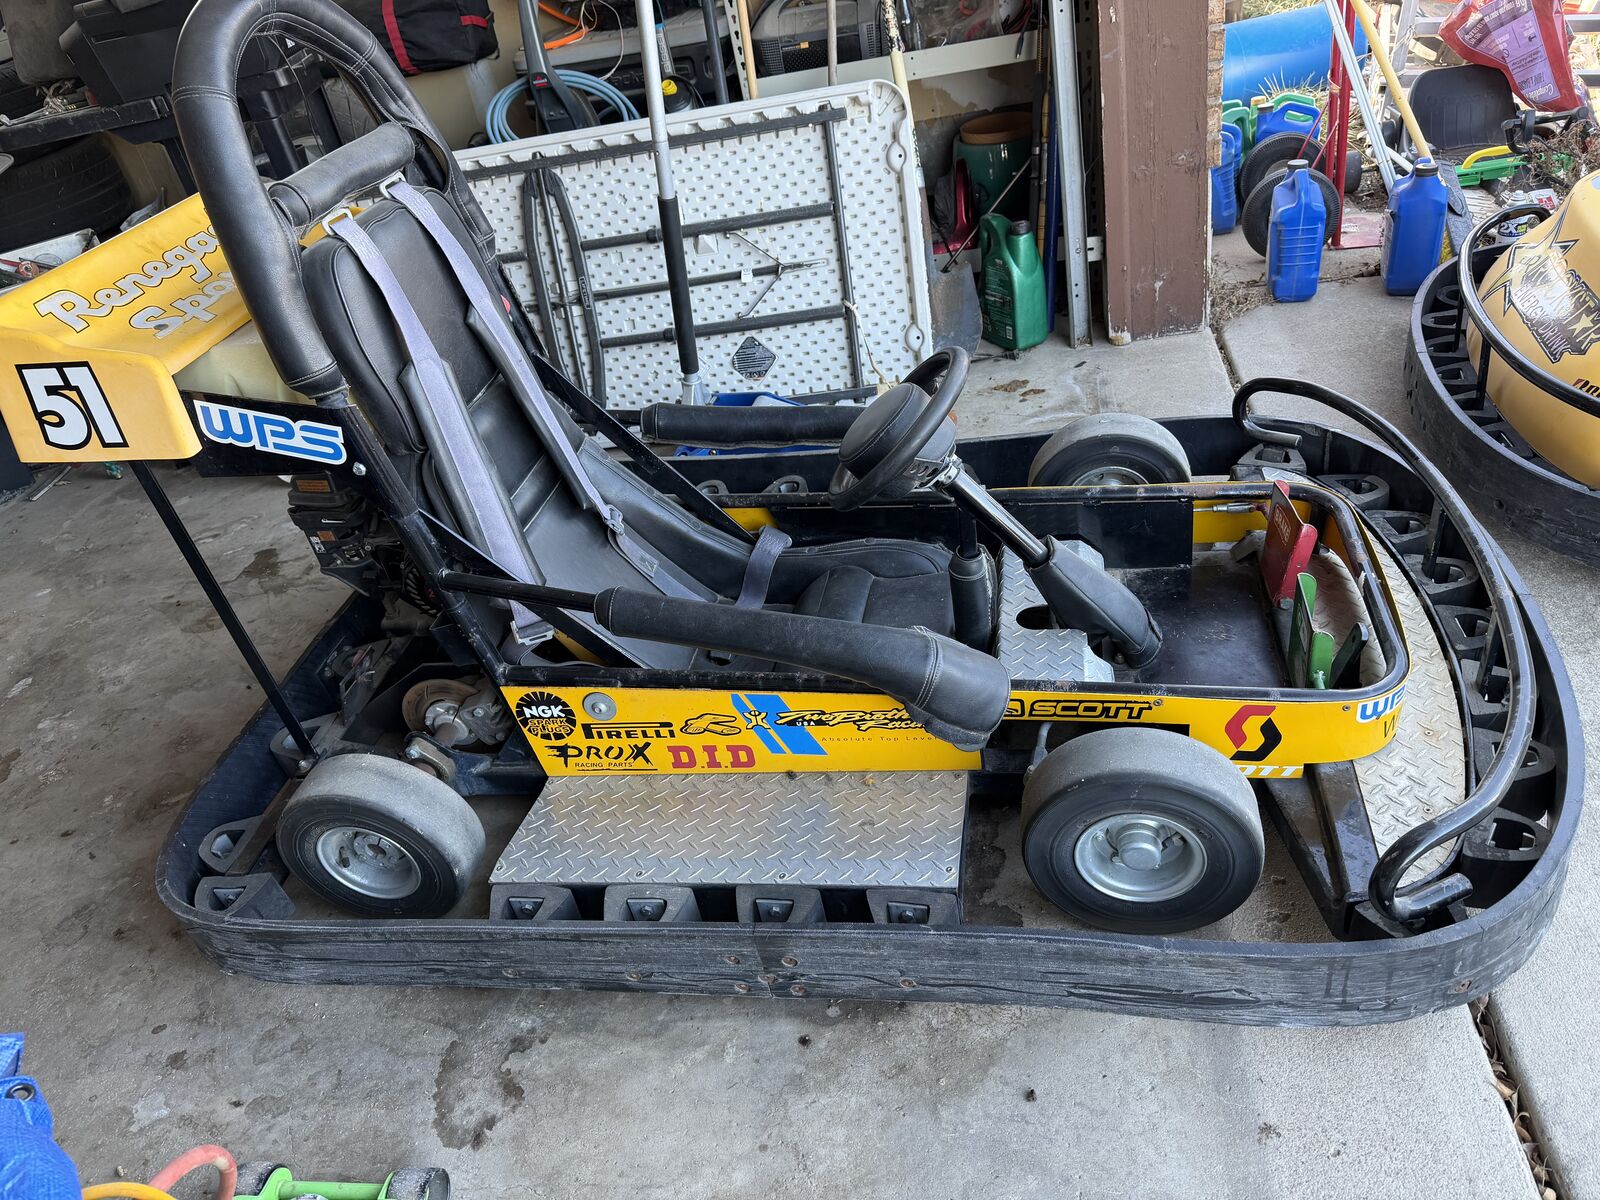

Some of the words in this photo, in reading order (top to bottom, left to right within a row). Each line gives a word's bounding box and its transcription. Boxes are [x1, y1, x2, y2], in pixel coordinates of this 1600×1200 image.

[33, 224, 220, 333] Renega
[129, 271, 236, 339] Spo
[1538, 319, 1570, 357] DRINK
[15, 361, 129, 450] 51
[199, 404, 346, 462] WPS
[1275, 509, 1290, 543] BRAKE
[523, 705, 566, 718] NGK
[528, 718, 567, 727] SPARK
[1028, 699, 1153, 720] SCOTT
[531, 725, 571, 734] PLUGS
[581, 722, 676, 739] PIRELLI
